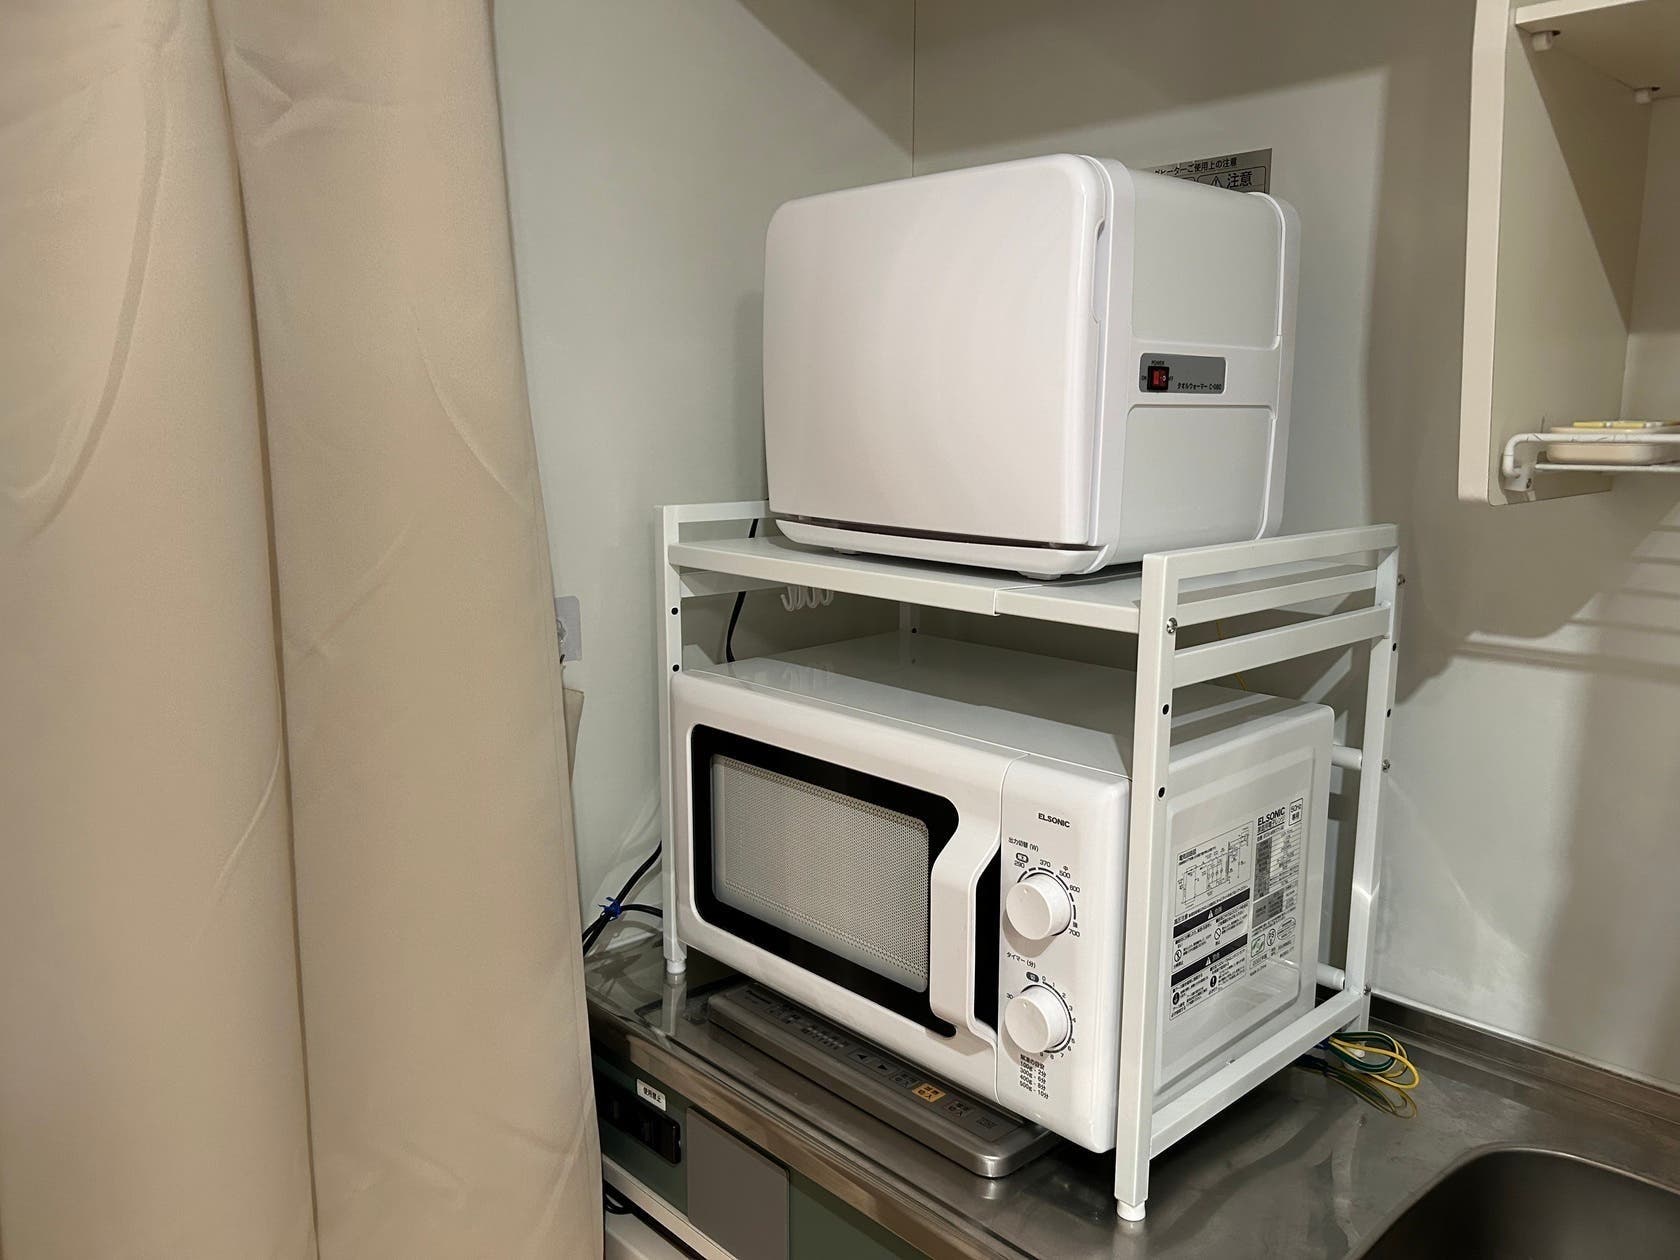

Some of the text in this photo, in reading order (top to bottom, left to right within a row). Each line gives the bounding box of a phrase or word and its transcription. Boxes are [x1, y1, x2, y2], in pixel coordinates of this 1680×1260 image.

[1227, 171, 1253, 188] 注意
[1038, 812, 1071, 828] ELSONIC
[1258, 806, 1285, 826] ELSONIC
[1069, 928, 1081, 938] 700
[1006, 951, 1026, 963] タイマー
